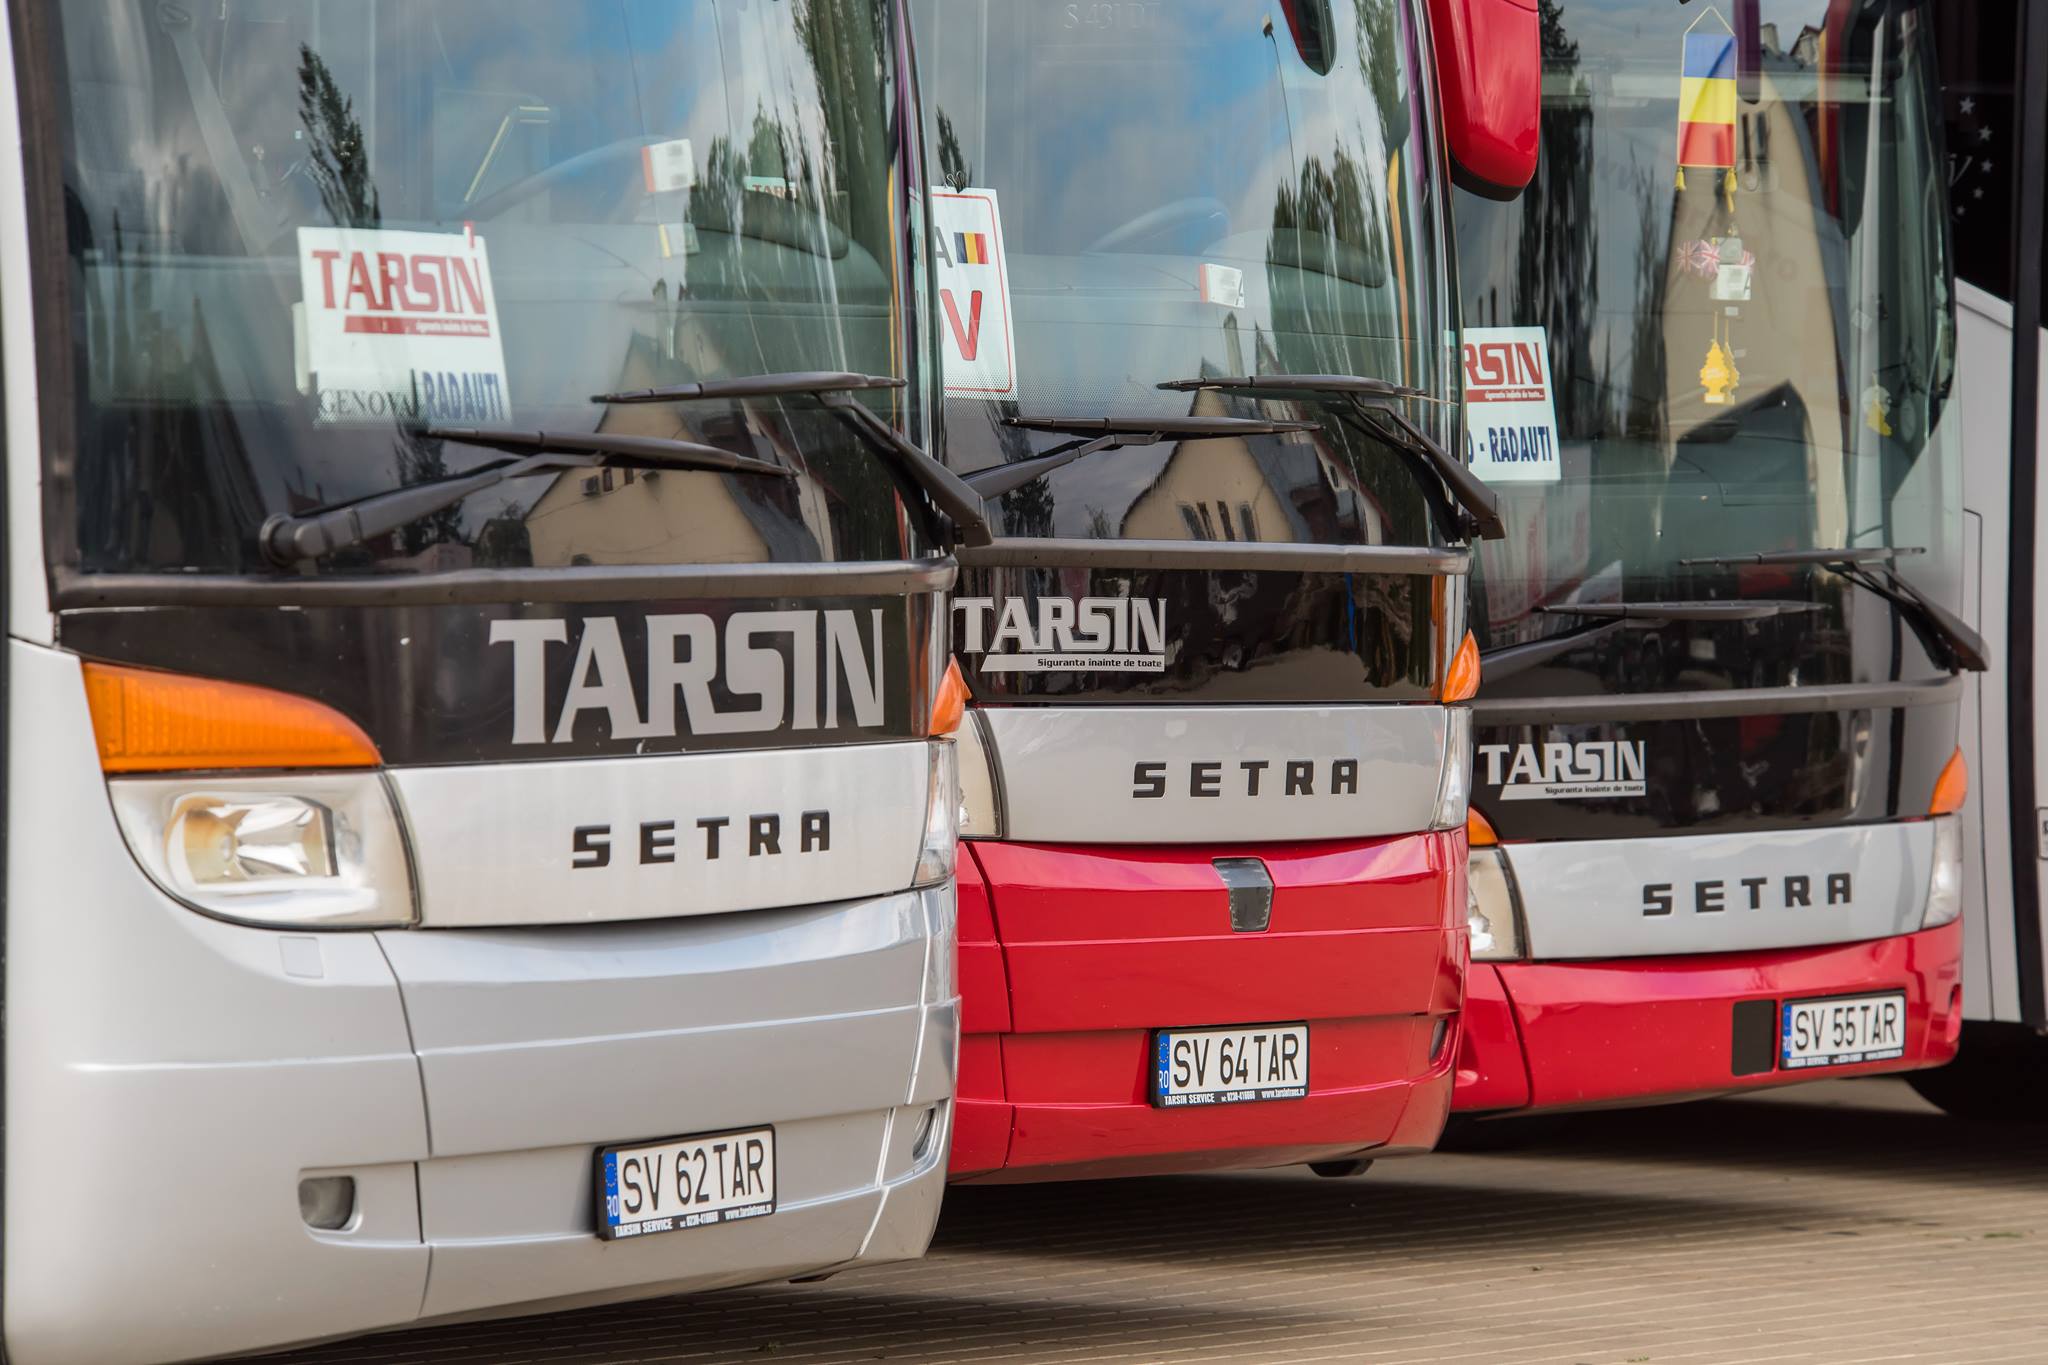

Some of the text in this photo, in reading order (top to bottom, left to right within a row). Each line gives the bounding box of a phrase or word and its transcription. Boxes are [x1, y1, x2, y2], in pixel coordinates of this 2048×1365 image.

[312, 250, 487, 315] TARSIN
[939, 288, 983, 361] V
[422, 371, 505, 421] RADAUTI
[1488, 426, 1553, 463] RADAUTI
[952, 596, 1168, 653] TARSIN
[488, 608, 884, 745] TARSIN
[1037, 658, 1086, 669] Siguranta
[1123, 658, 1135, 667] de
[1132, 758, 1358, 798] SETRA
[1478, 740, 1646, 785] TARSIN
[572, 809, 830, 869] SETRA
[1642, 872, 1853, 916] SETRA
[1795, 1009, 1825, 1051] SV
[1159, 1070, 1169, 1088] RO
[1174, 1038, 1210, 1088] SV
[1188, 1093, 1215, 1104] SERVICE
[623, 1153, 662, 1214] SV
[607, 1195, 619, 1217] RO
[642, 1218, 673, 1234] SERVICE
